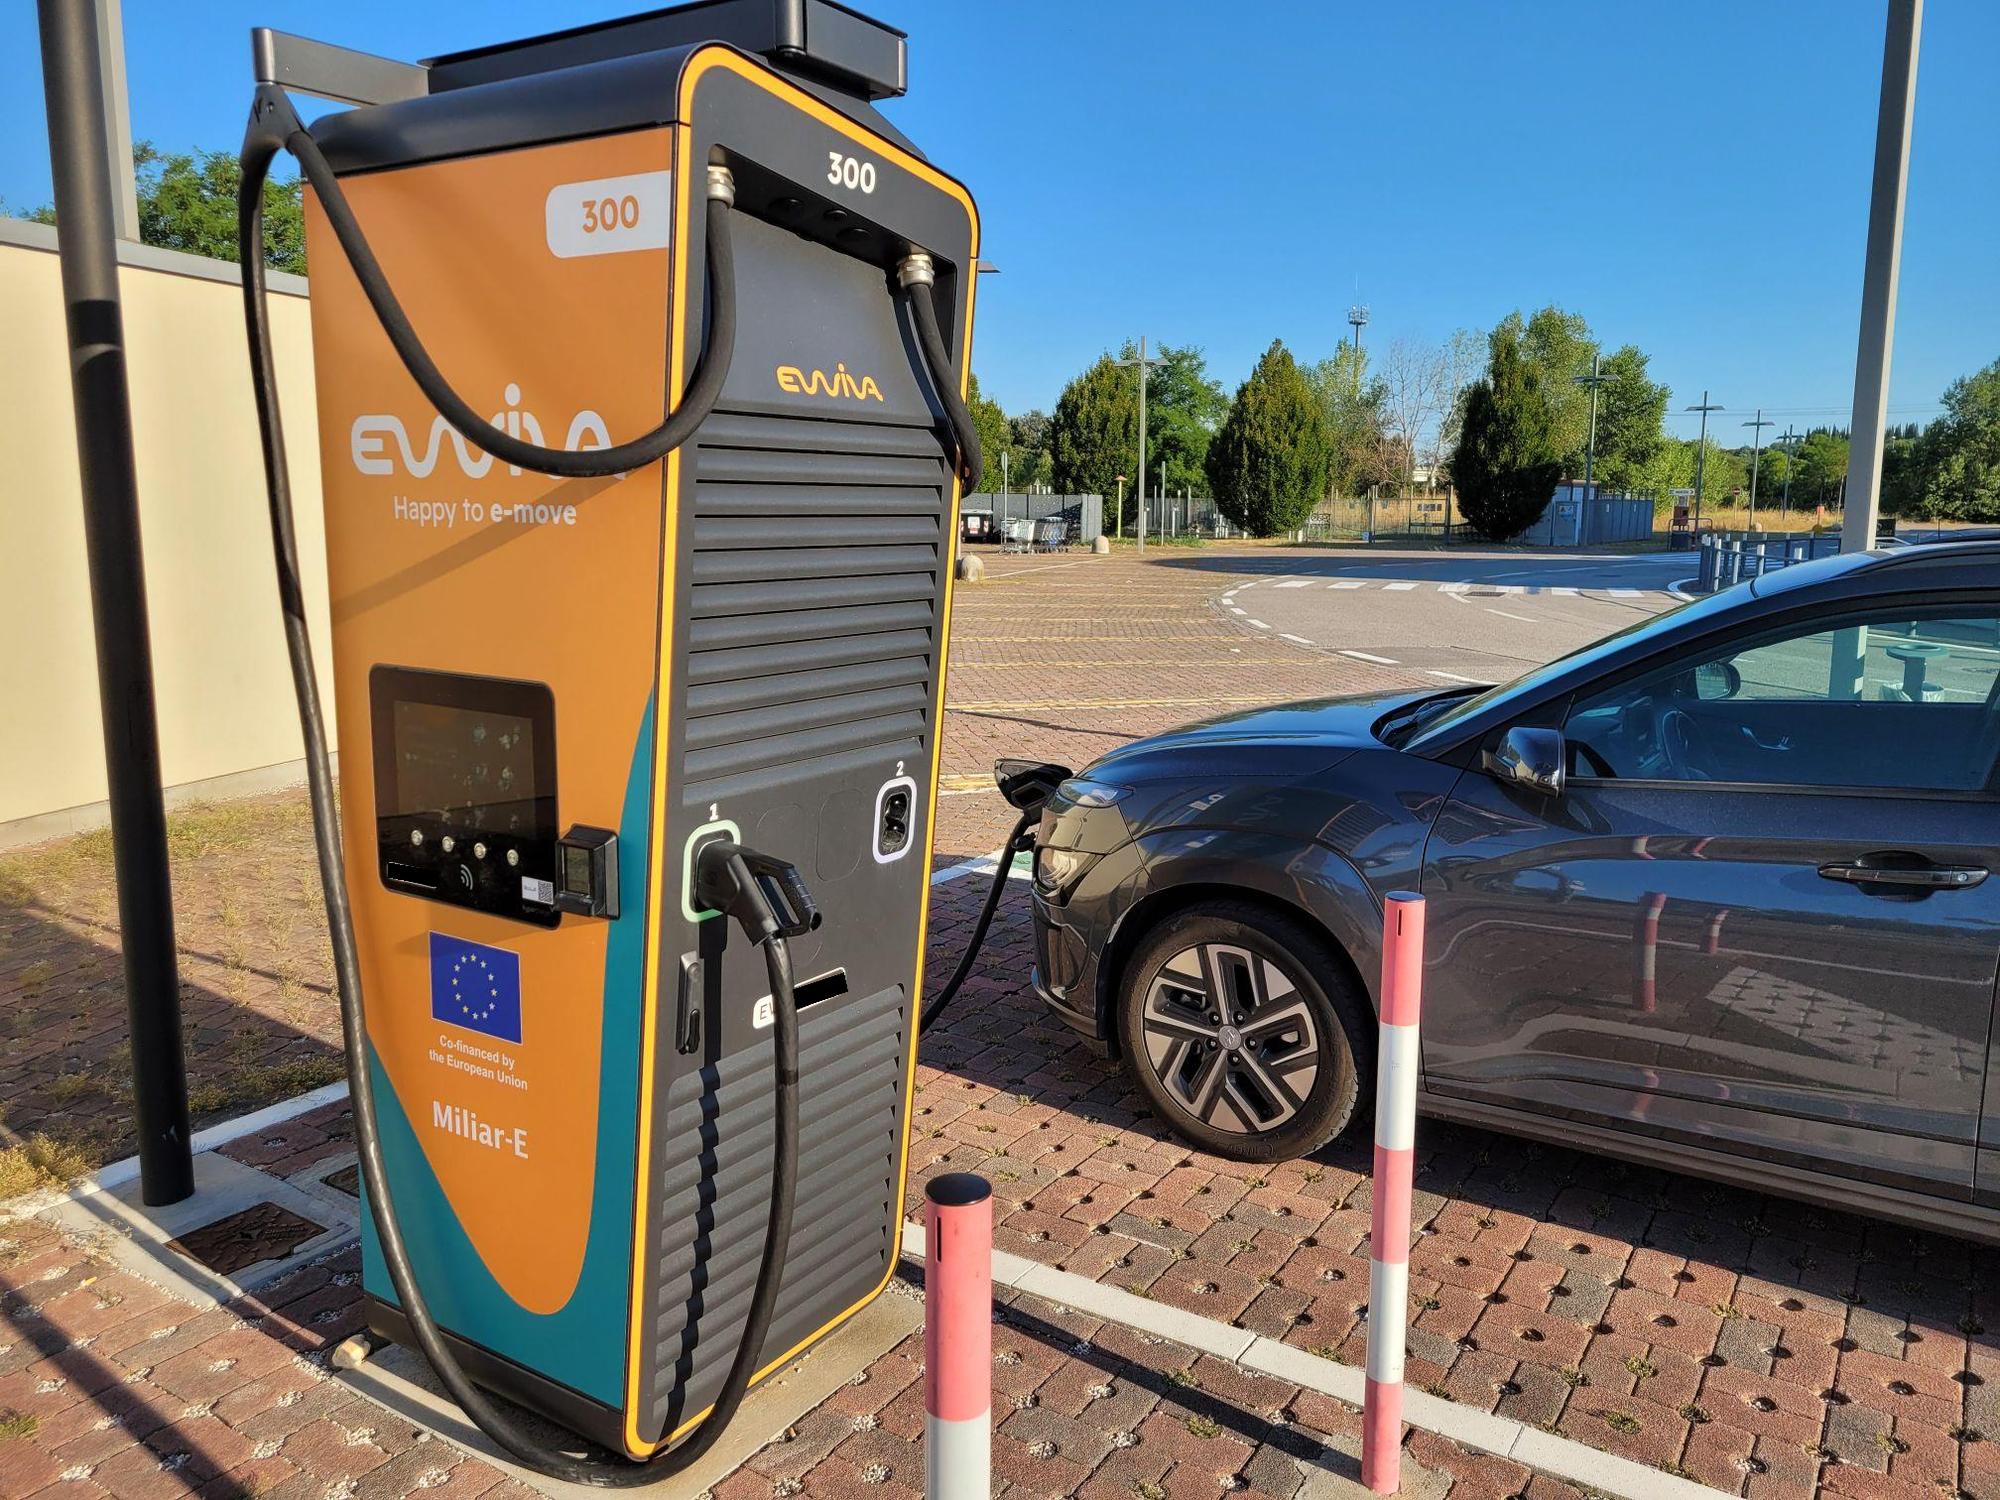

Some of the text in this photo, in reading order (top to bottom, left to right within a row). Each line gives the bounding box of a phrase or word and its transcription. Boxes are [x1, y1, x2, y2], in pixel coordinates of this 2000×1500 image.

[827, 151, 877, 194] 300
[581, 194, 640, 233] 300
[394, 496, 578, 528] Happy to e-move
[895, 760, 904, 777] 2
[709, 802, 719, 821] 1
[429, 1048, 528, 1091] the European Union
[439, 1034, 516, 1071] Co-financed by
[432, 1100, 529, 1160] Miliar-E
